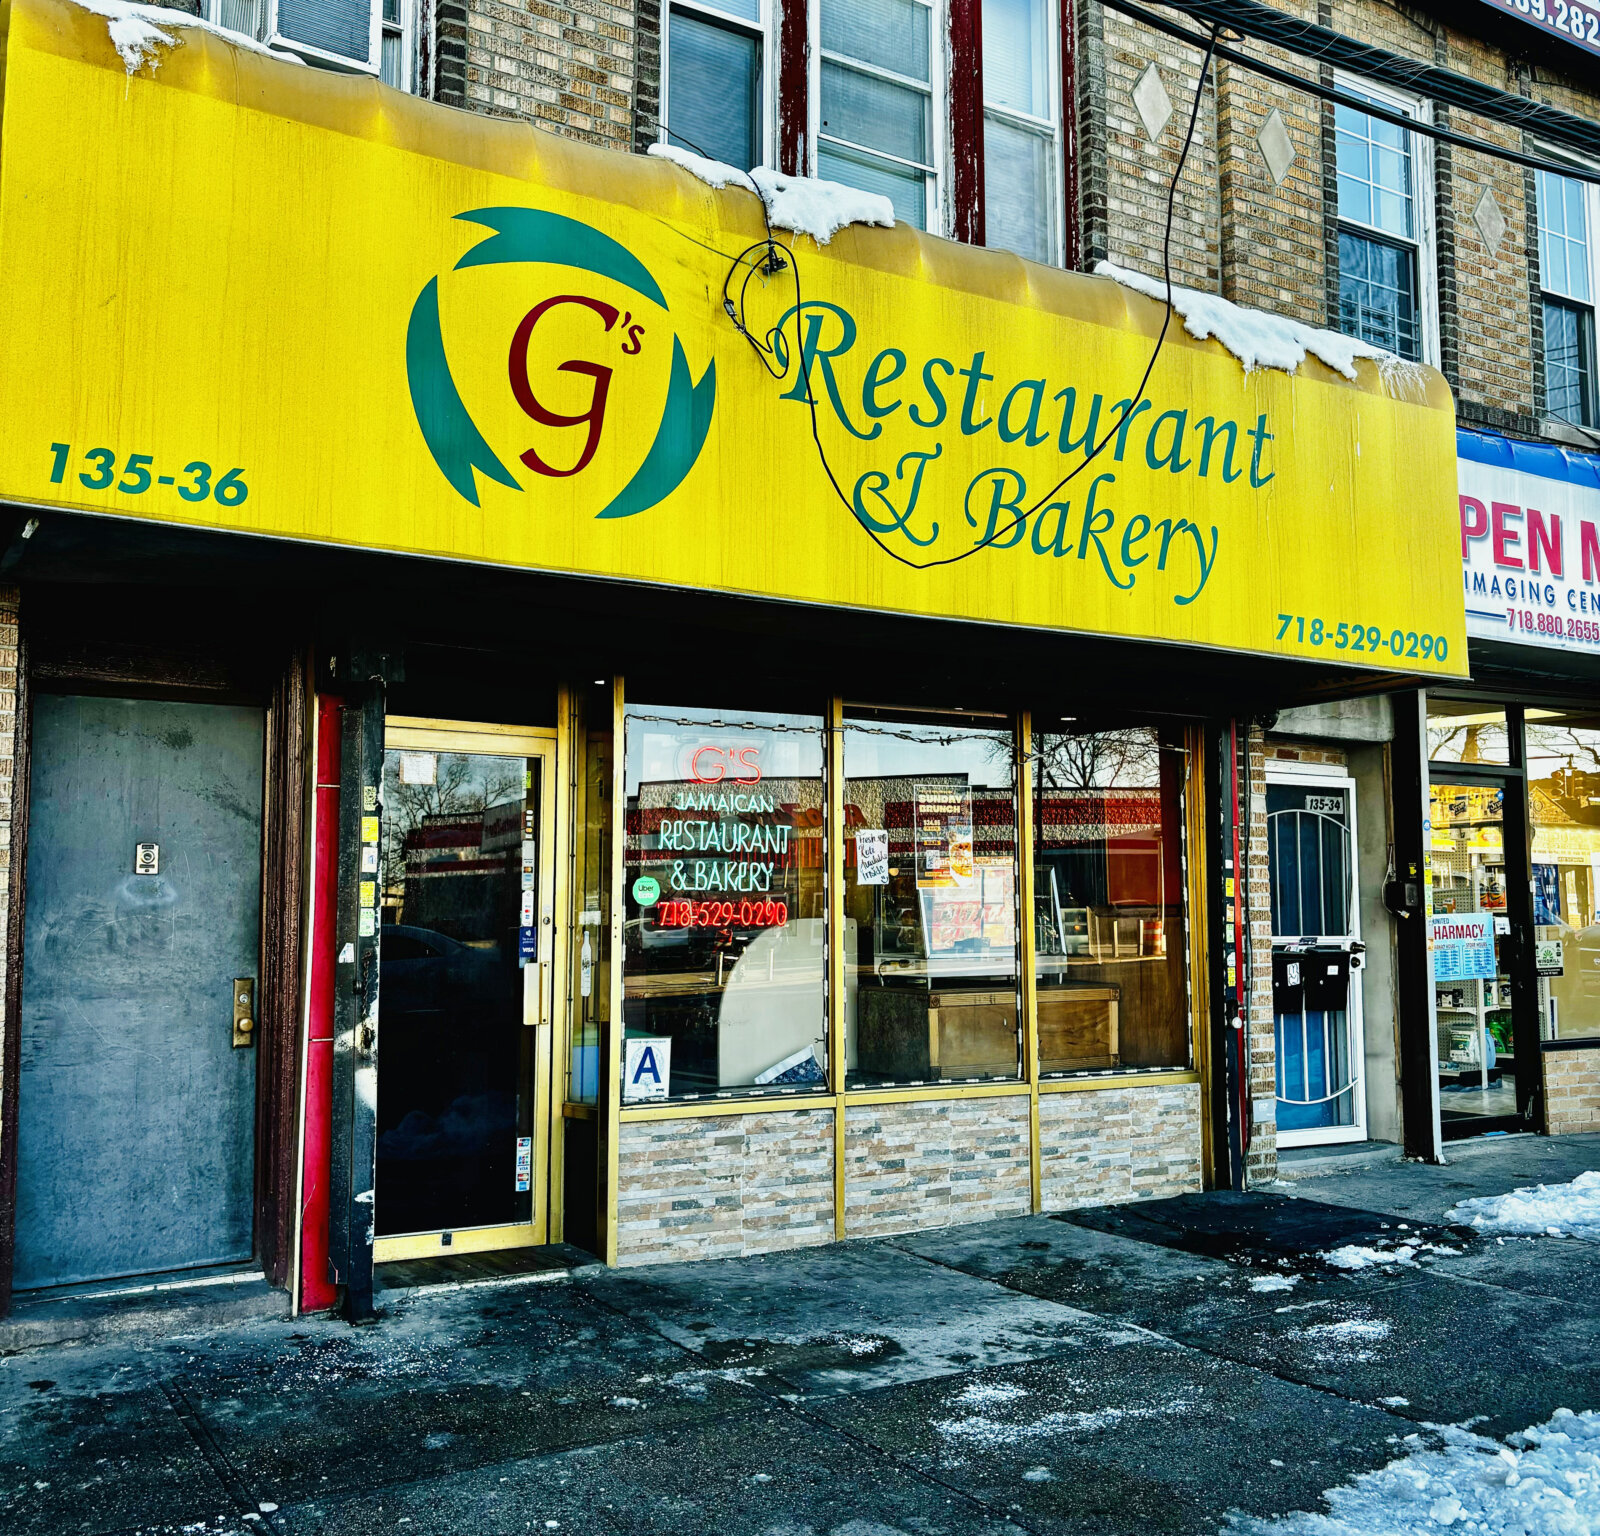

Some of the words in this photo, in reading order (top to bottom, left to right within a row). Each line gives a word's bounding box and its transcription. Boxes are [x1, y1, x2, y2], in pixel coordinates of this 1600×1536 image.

[508, 295, 646, 478] G's
[774, 301, 1276, 489] Restaurant
[48, 442, 249, 507] 135-36
[964, 467, 1218, 606] Bakery
[1464, 570, 1556, 604] IMAGING
[1275, 613, 1448, 662] 718-529-0290
[1506, 608, 1600, 641] 718.880.2655
[674, 792, 775, 813] JAMAICAN
[918, 794, 963, 804] SUNDAY
[918, 805, 961, 813] BRUNCH
[1309, 798, 1341, 811] 135-34
[658, 819, 793, 854] RESTAURANT
[695, 861, 775, 892] BAKERY
[658, 901, 788, 927] 718-529-0290
[632, 1046, 661, 1084] A
